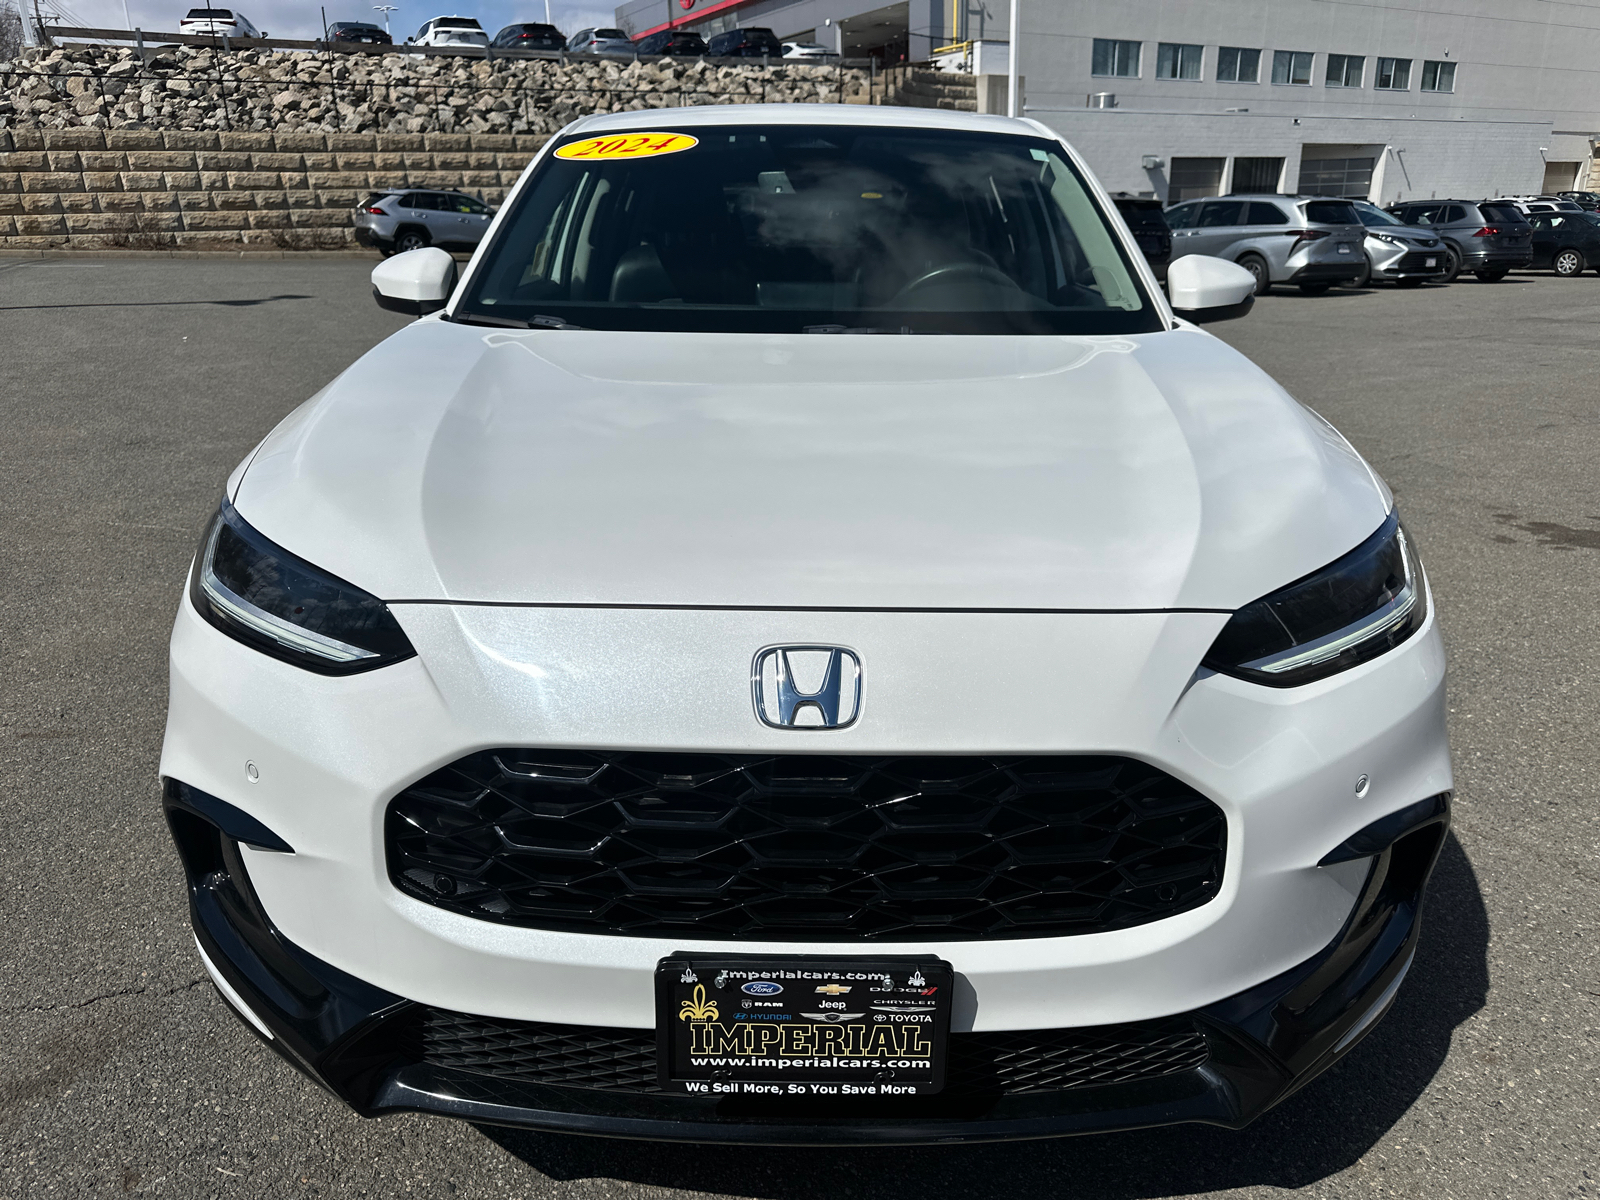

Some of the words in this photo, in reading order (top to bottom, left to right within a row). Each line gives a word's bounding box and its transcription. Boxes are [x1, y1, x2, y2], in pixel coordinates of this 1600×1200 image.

[572, 136, 679, 157] 2024
[721, 970, 885, 981] Imperialcars.com
[750, 985, 774, 994] Ford
[818, 1000, 846, 1010] Jeep
[888, 1014, 932, 1023] TOYOTA
[690, 1022, 931, 1057] IMPERIAL
[691, 1056, 931, 1069] www.imperialcars.com
[685, 1082, 709, 1092] We
[712, 1083, 739, 1093] Sell
[743, 1083, 784, 1095] More,
[787, 1084, 806, 1094] So
[810, 1084, 838, 1094] You
[841, 1084, 877, 1095] Save
[880, 1084, 917, 1095] More
